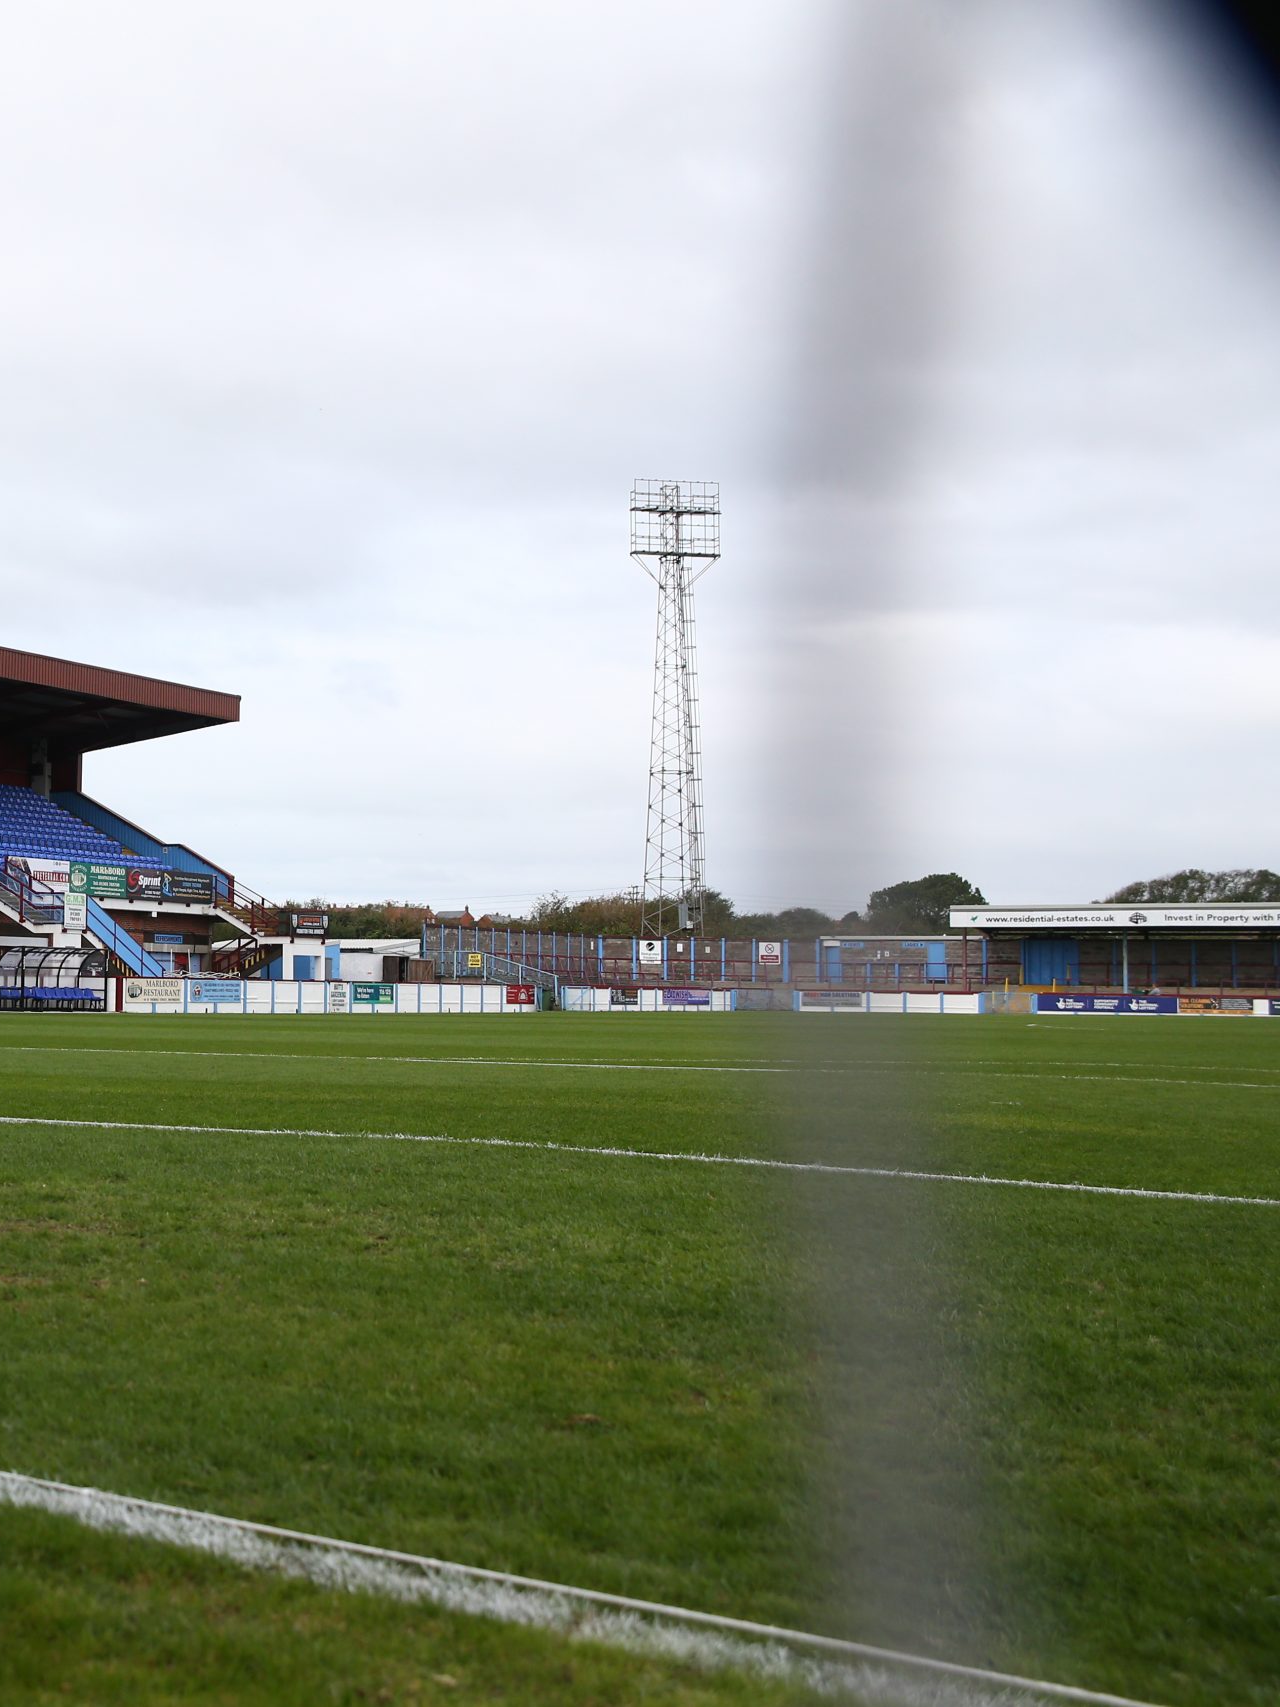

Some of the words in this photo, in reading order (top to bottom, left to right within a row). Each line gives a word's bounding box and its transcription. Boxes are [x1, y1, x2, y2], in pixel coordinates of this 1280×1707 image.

[90, 866, 126, 876] MARLBORO
[138, 874, 161, 889] Sprint
[985, 914, 1114, 923] www.residential-estates.co.uk
[1195, 913, 1204, 921] in
[1206, 913, 1248, 923] Property
[1252, 913, 1274, 921] with
[145, 980, 179, 988] MARLBORO
[143, 988, 180, 996] RESTAURANT
